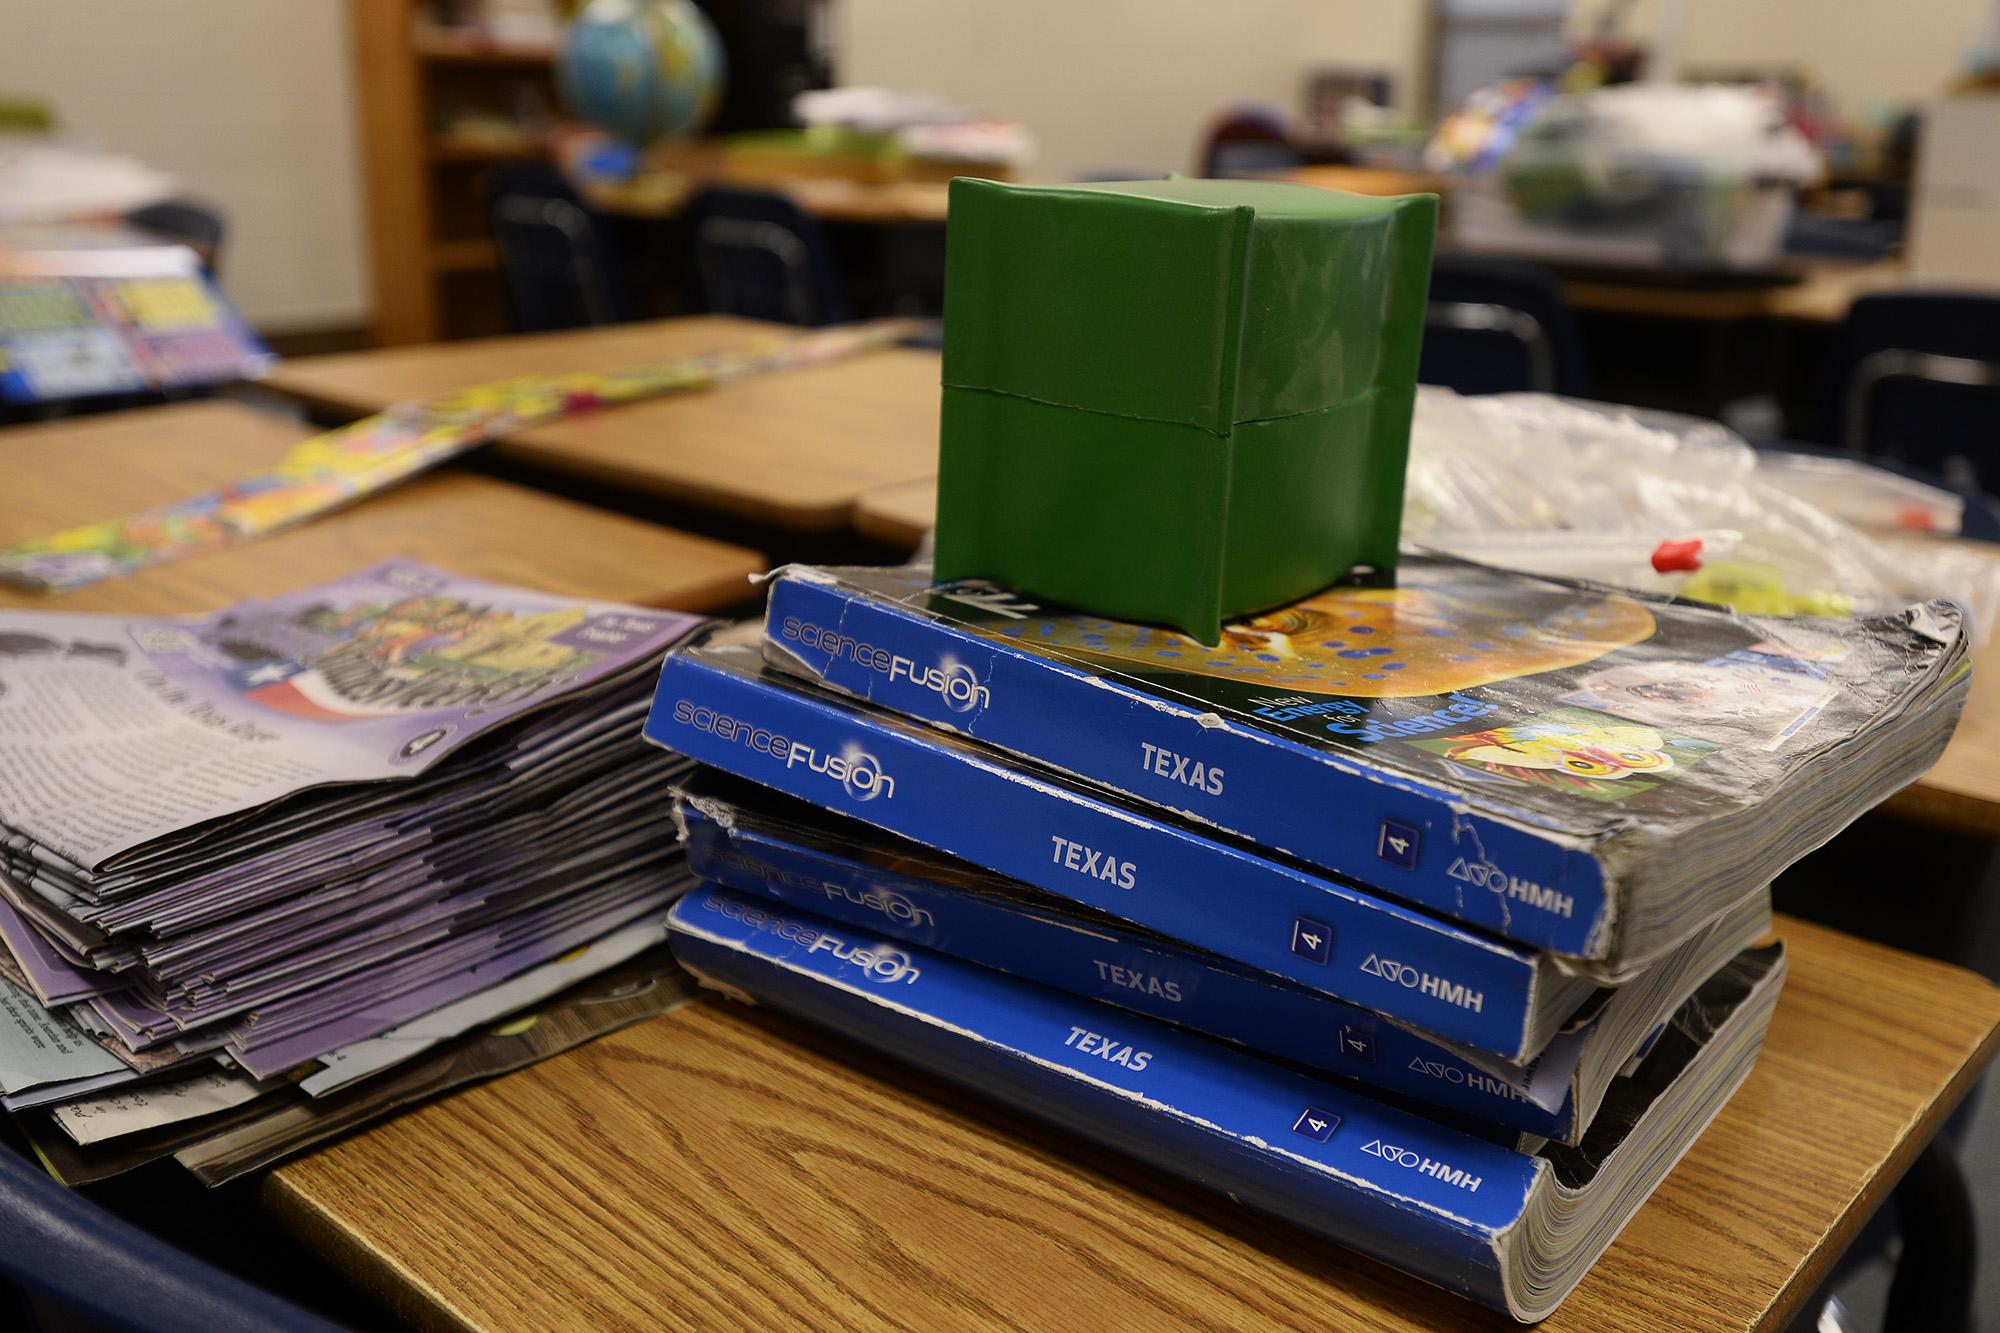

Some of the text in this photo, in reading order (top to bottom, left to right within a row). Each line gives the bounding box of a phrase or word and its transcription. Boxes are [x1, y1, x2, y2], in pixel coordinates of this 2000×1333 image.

[1248, 696, 1313, 709] New
[1253, 699, 1370, 722] Energy
[1322, 714, 1361, 724] for
[1326, 692, 1498, 743] Science!
[1141, 742, 1225, 796] TEXAS
[1052, 835, 1136, 890] TEXAS
[1387, 833, 1410, 856] 4
[1507, 875, 1574, 919] HMH
[1301, 930, 1323, 951] 4
[1093, 959, 1182, 1002] TEXAS
[1420, 972, 1484, 1014] HMH
[1065, 1026, 1153, 1071] TEXAS
[1346, 1036, 1368, 1054] 4
[1307, 1115, 1328, 1133] 4
[1419, 1157, 1483, 1194] HMH
